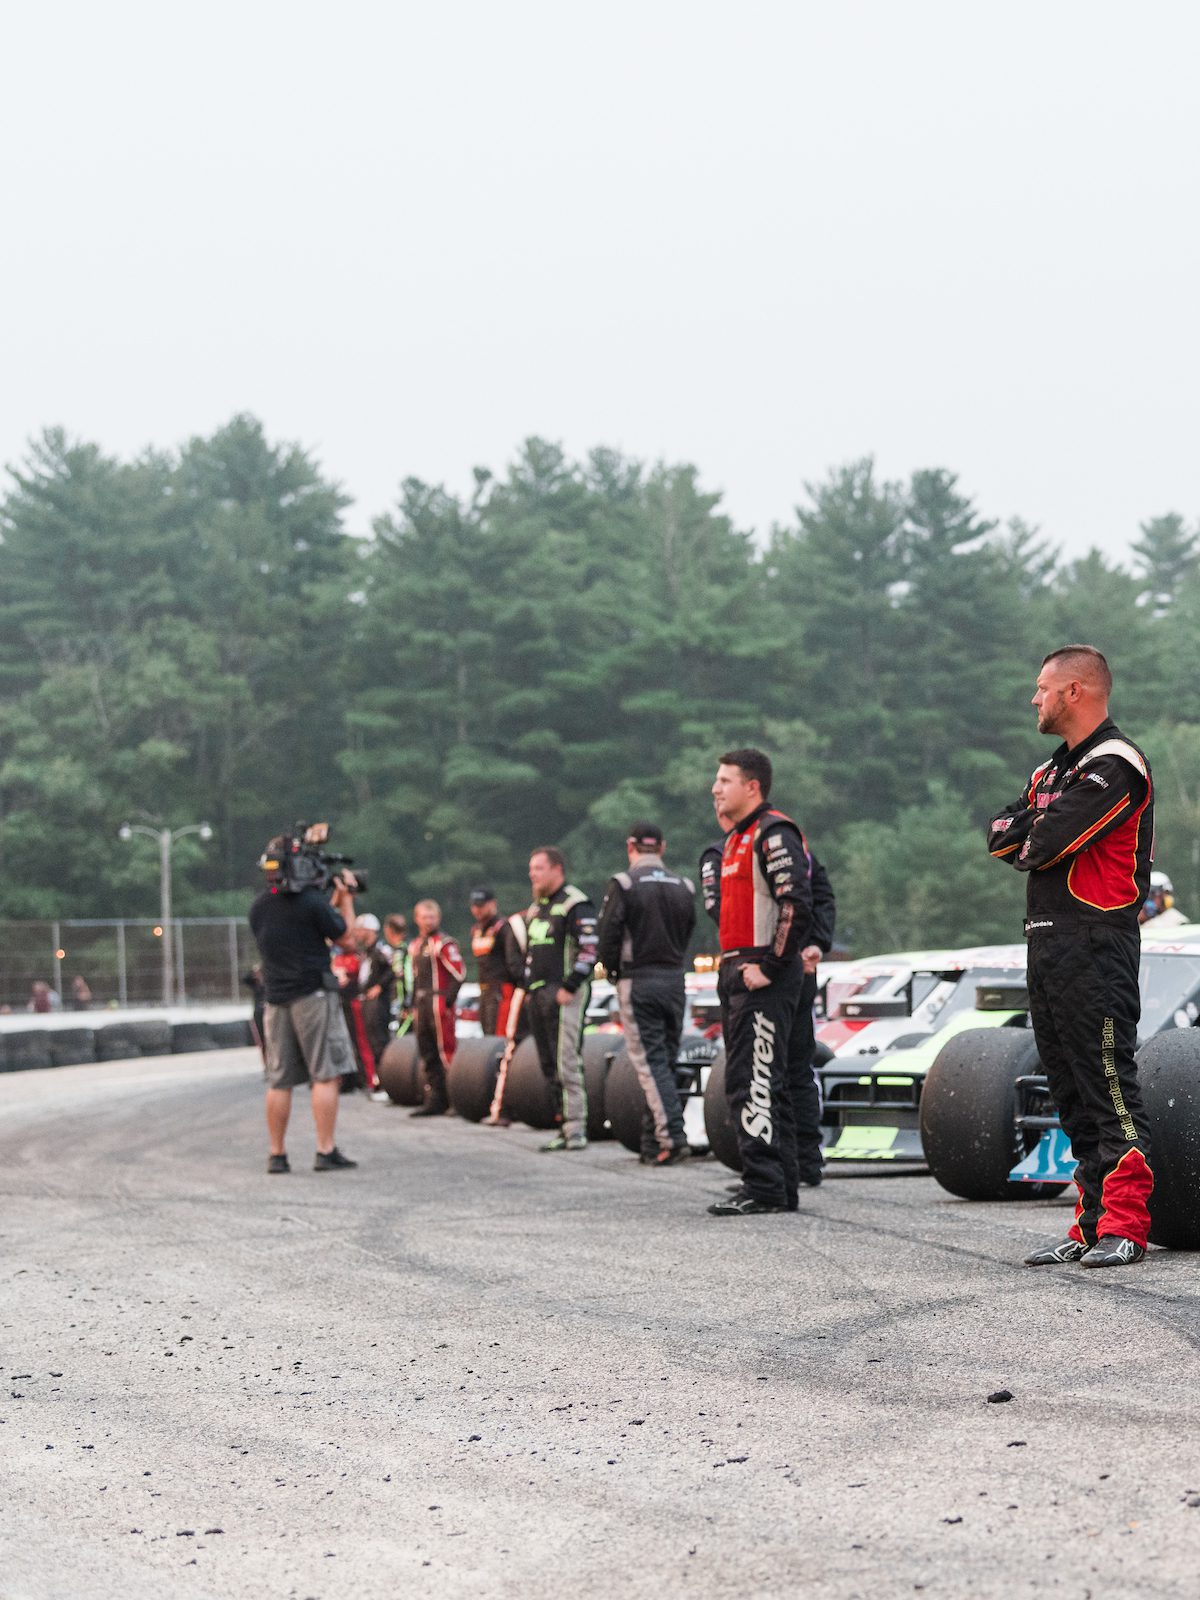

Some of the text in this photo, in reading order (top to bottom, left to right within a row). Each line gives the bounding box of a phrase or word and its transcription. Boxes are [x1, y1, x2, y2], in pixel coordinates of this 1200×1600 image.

[1102, 1017, 1115, 1049] Better
[741, 1011, 776, 1145] Starrett
[1102, 1051, 1117, 1077] Build
[1121, 1113, 1138, 1140] Build
